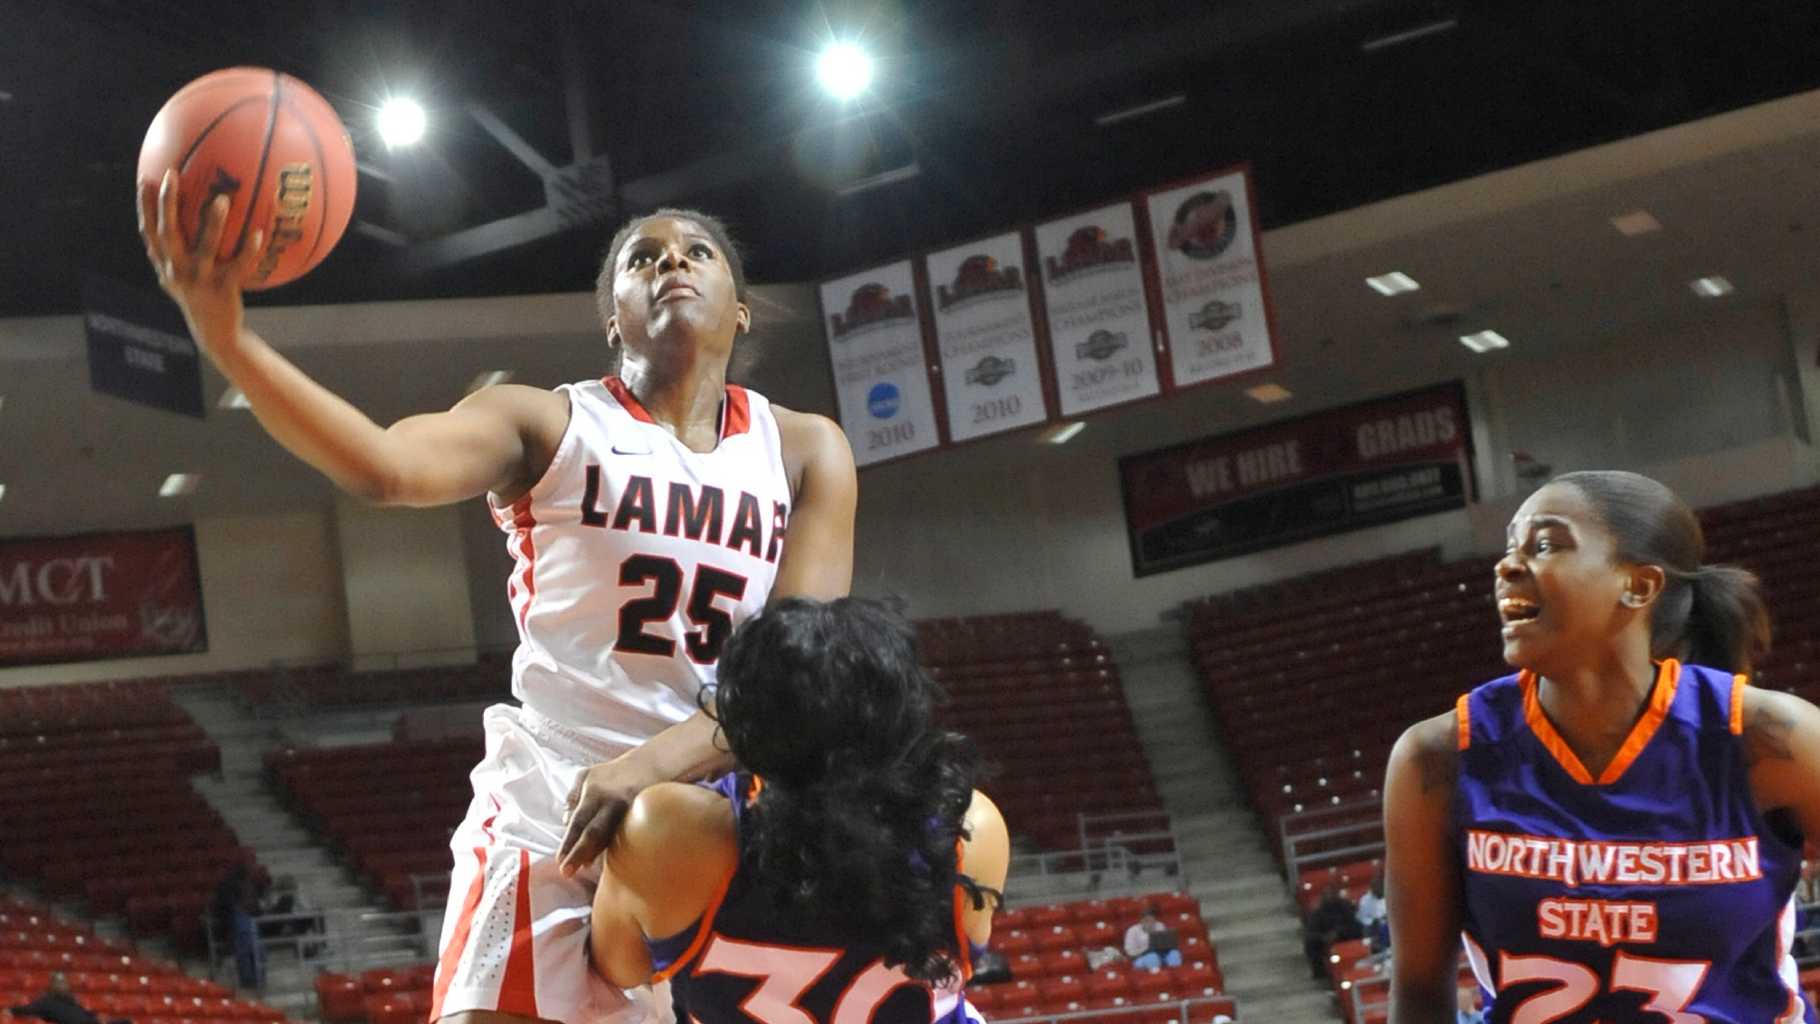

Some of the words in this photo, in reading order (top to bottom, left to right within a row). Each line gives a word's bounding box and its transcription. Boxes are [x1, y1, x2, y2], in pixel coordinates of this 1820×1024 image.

[1184, 456, 1233, 497] WE
[1236, 440, 1301, 486] HIRE
[1356, 406, 1457, 459] GRADS
[613, 552, 748, 666] 25
[1466, 830, 1763, 886] NORTHWESTERN
[1538, 897, 1659, 946] STATE
